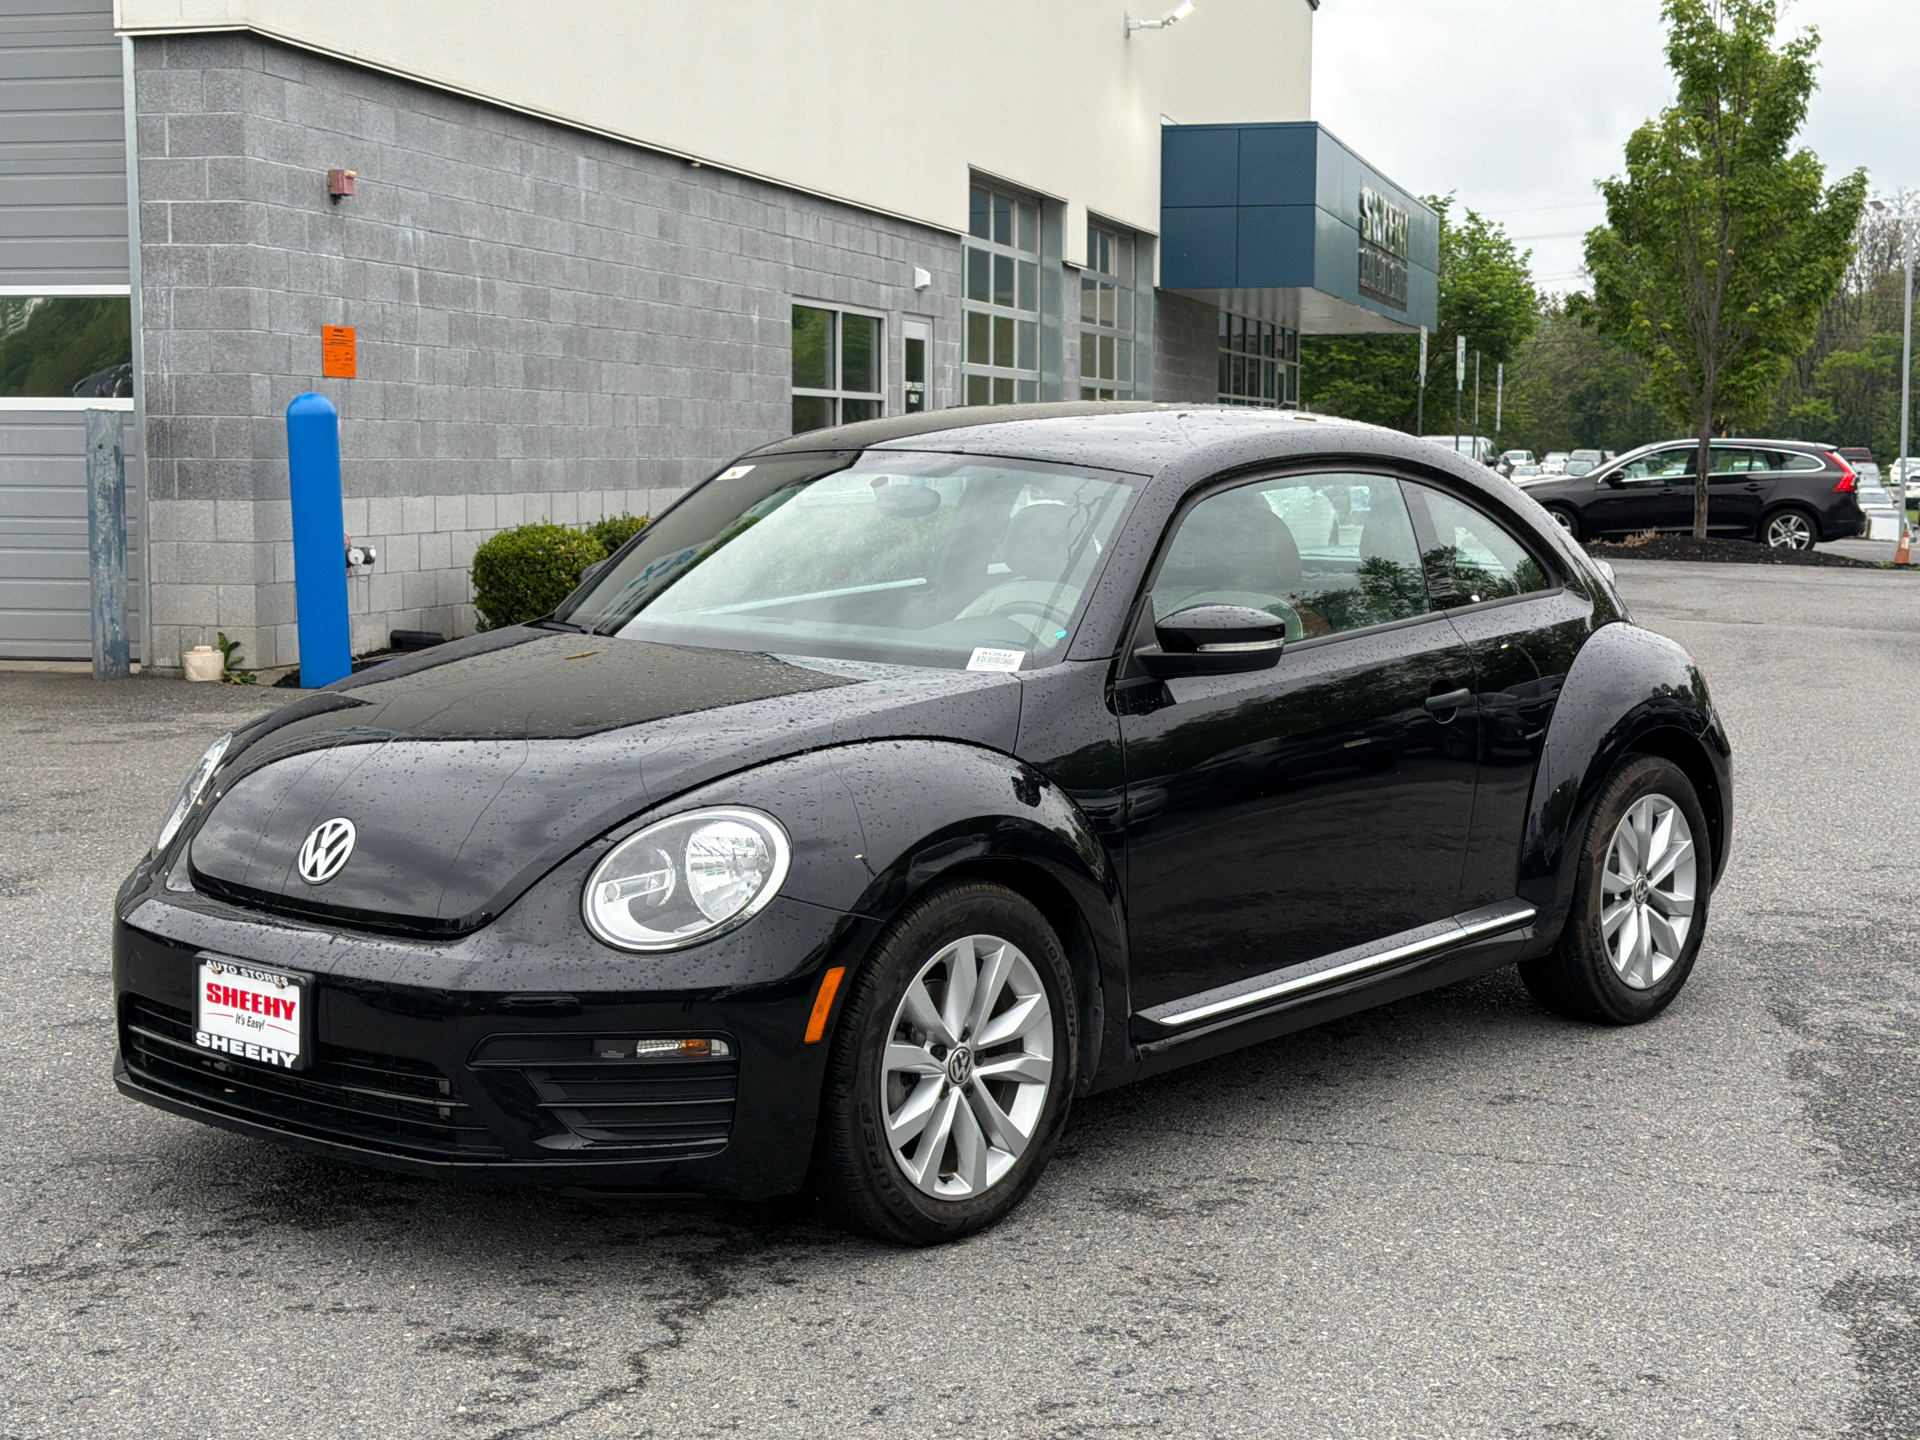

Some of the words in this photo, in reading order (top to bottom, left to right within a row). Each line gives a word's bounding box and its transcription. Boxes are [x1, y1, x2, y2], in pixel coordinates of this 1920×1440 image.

[205, 959, 238, 975] AUTO
[240, 968, 289, 986] STORES
[206, 982, 297, 1021] SHEEHY
[235, 1013, 245, 1025] It's
[246, 1015, 265, 1032] Easy!
[195, 1031, 297, 1069] SHEEHY
